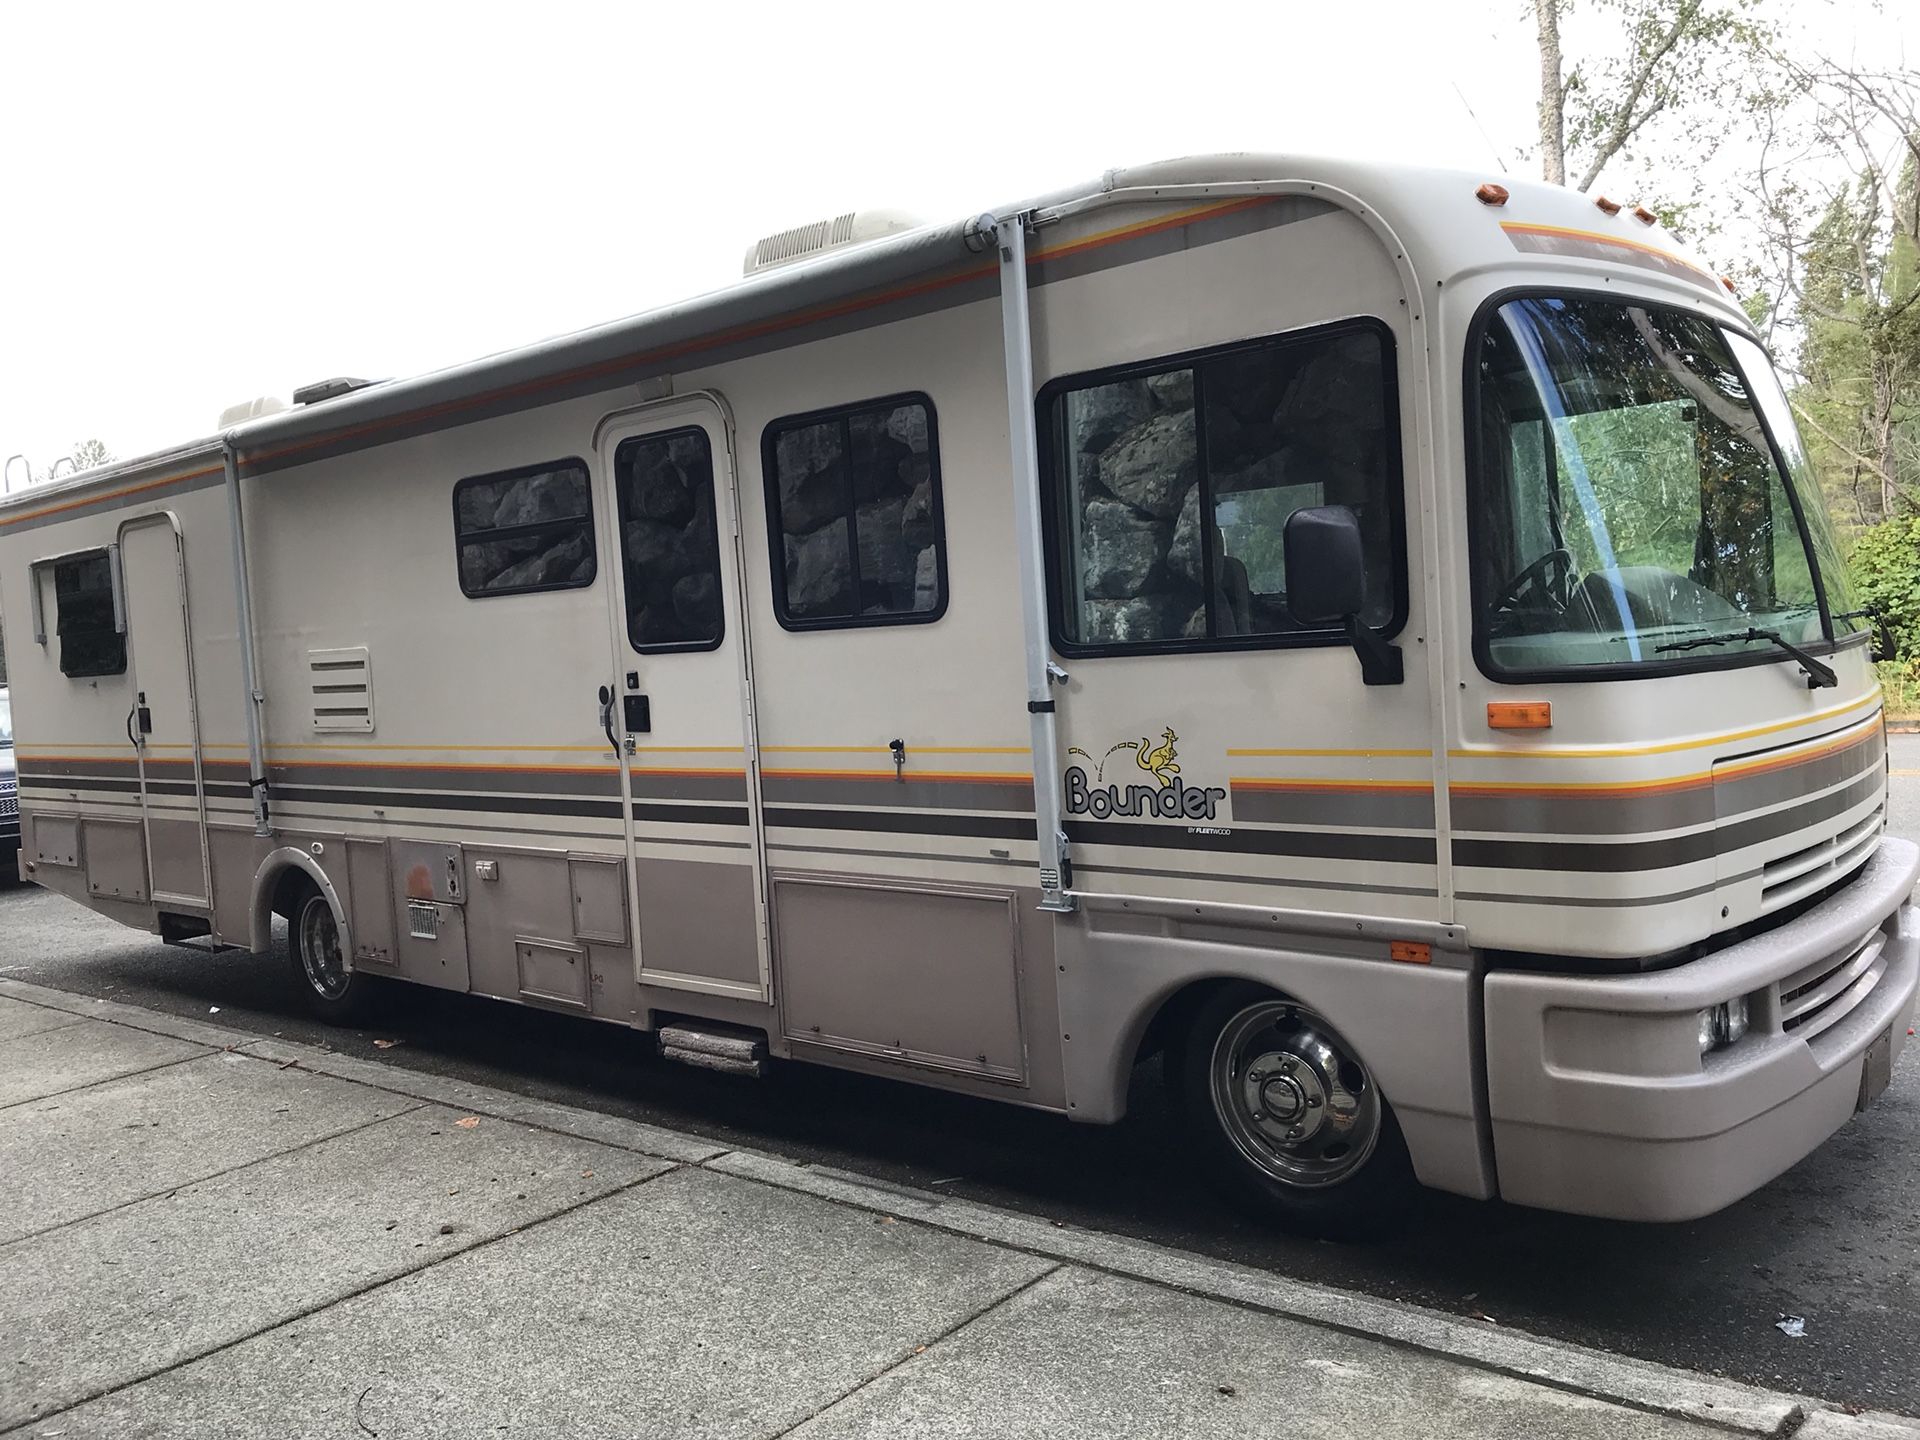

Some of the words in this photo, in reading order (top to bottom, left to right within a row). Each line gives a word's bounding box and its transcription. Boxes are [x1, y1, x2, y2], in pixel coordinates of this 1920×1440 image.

[1065, 766, 1226, 819] Bounder
[1187, 826, 1196, 834] BY
[1195, 826, 1231, 836] FLEETWOOD
